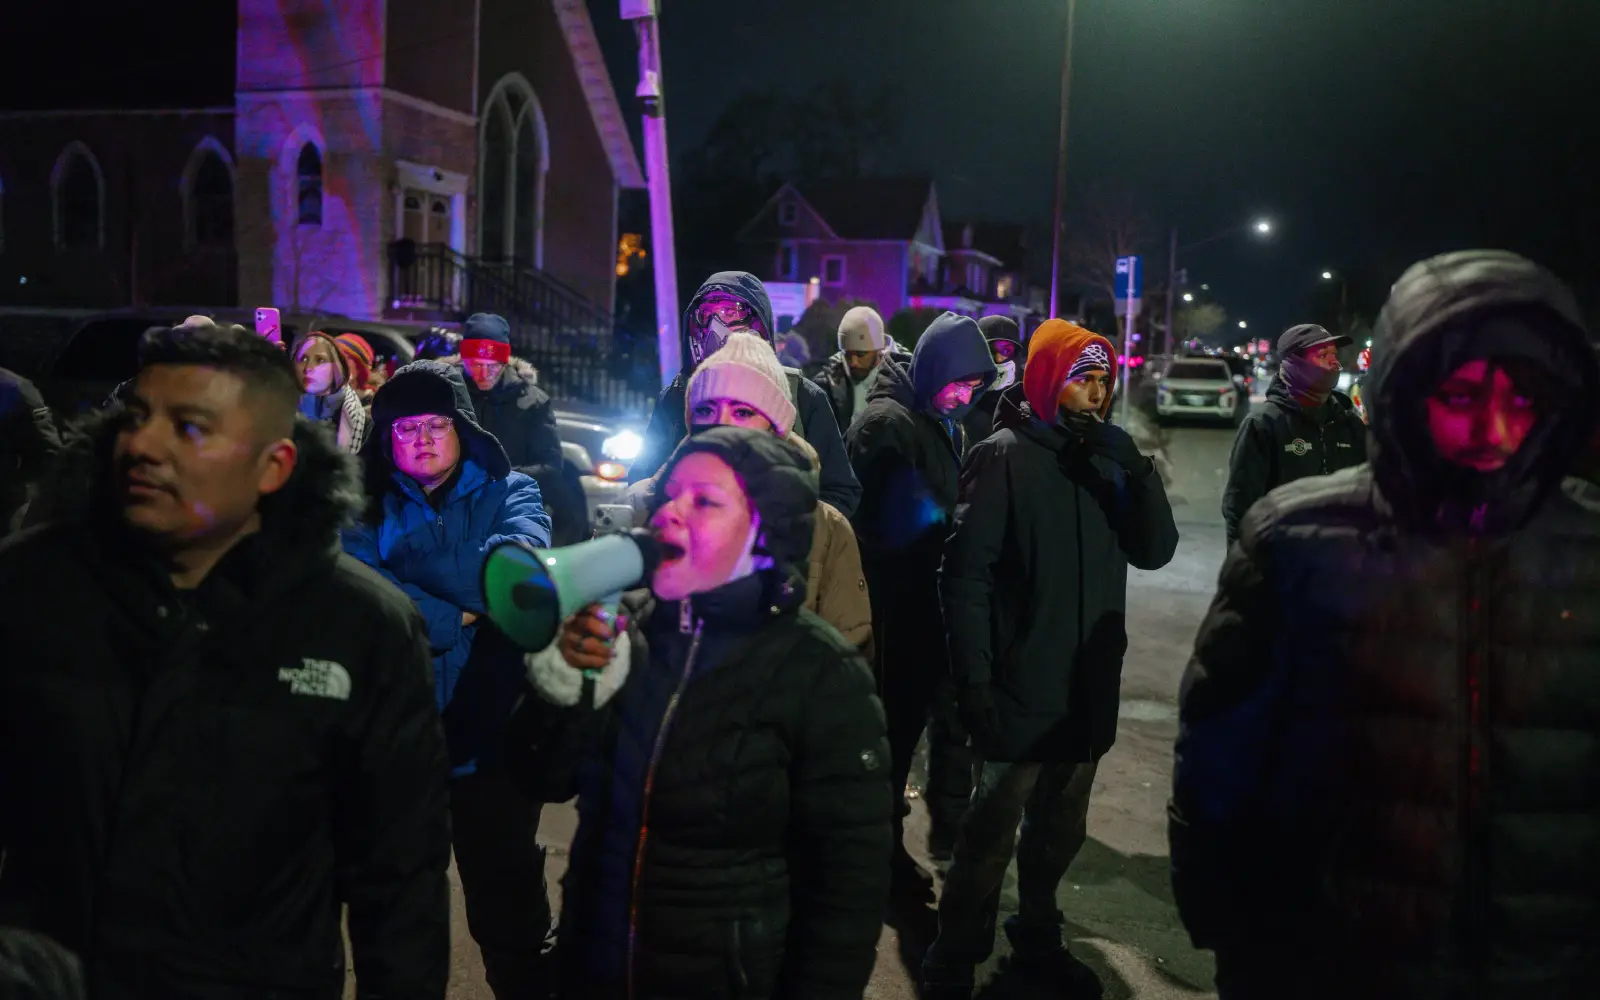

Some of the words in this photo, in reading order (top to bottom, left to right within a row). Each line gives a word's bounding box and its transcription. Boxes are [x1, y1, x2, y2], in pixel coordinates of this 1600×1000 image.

[302, 657, 328, 671] THE
[278, 667, 327, 683] NORTH
[290, 680, 326, 696] FACE
